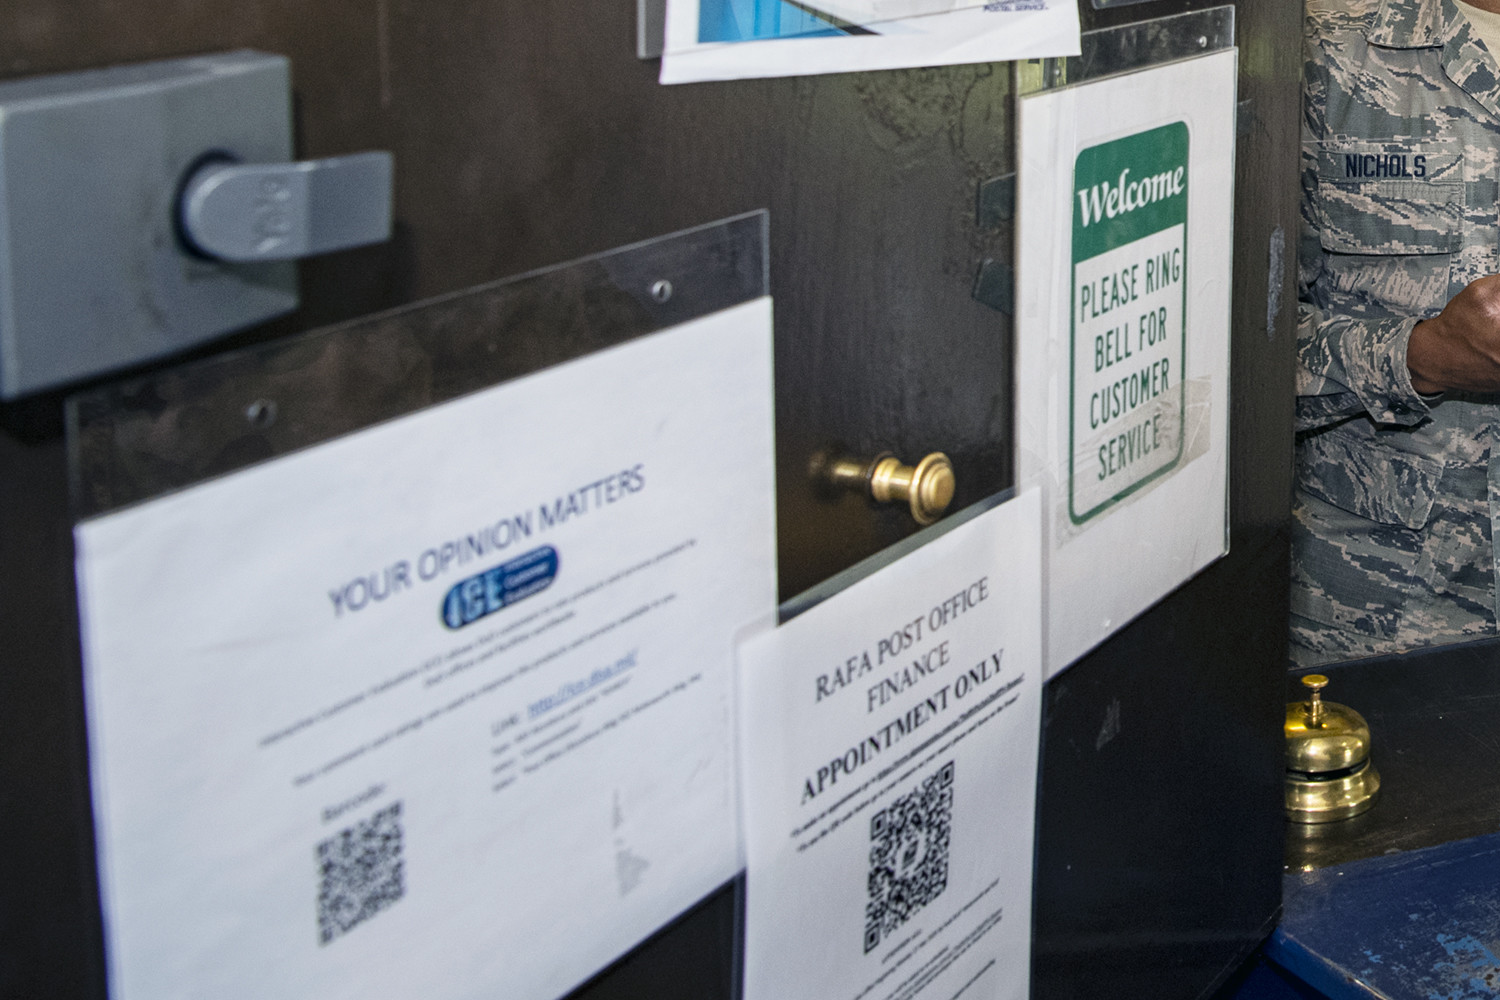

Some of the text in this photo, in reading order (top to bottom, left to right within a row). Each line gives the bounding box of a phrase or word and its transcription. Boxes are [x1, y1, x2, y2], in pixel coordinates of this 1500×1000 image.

[1078, 165, 1185, 227] Welcome
[1345, 153, 1427, 178] NICHOLS
[1081, 248, 1180, 322] PLEASE RING
[1095, 307, 1167, 373] BELL FOR
[1090, 357, 1170, 430] CUSTOMER
[1098, 414, 1161, 481] SERVICE
[329, 463, 645, 617] YOUR OPINION MATTERS
[816, 576, 989, 703] RAFA POST OFFICE
[867, 640, 949, 715] FINANCE
[801, 685, 950, 805] APPOINTMENT
[955, 649, 1004, 699] ONLY
